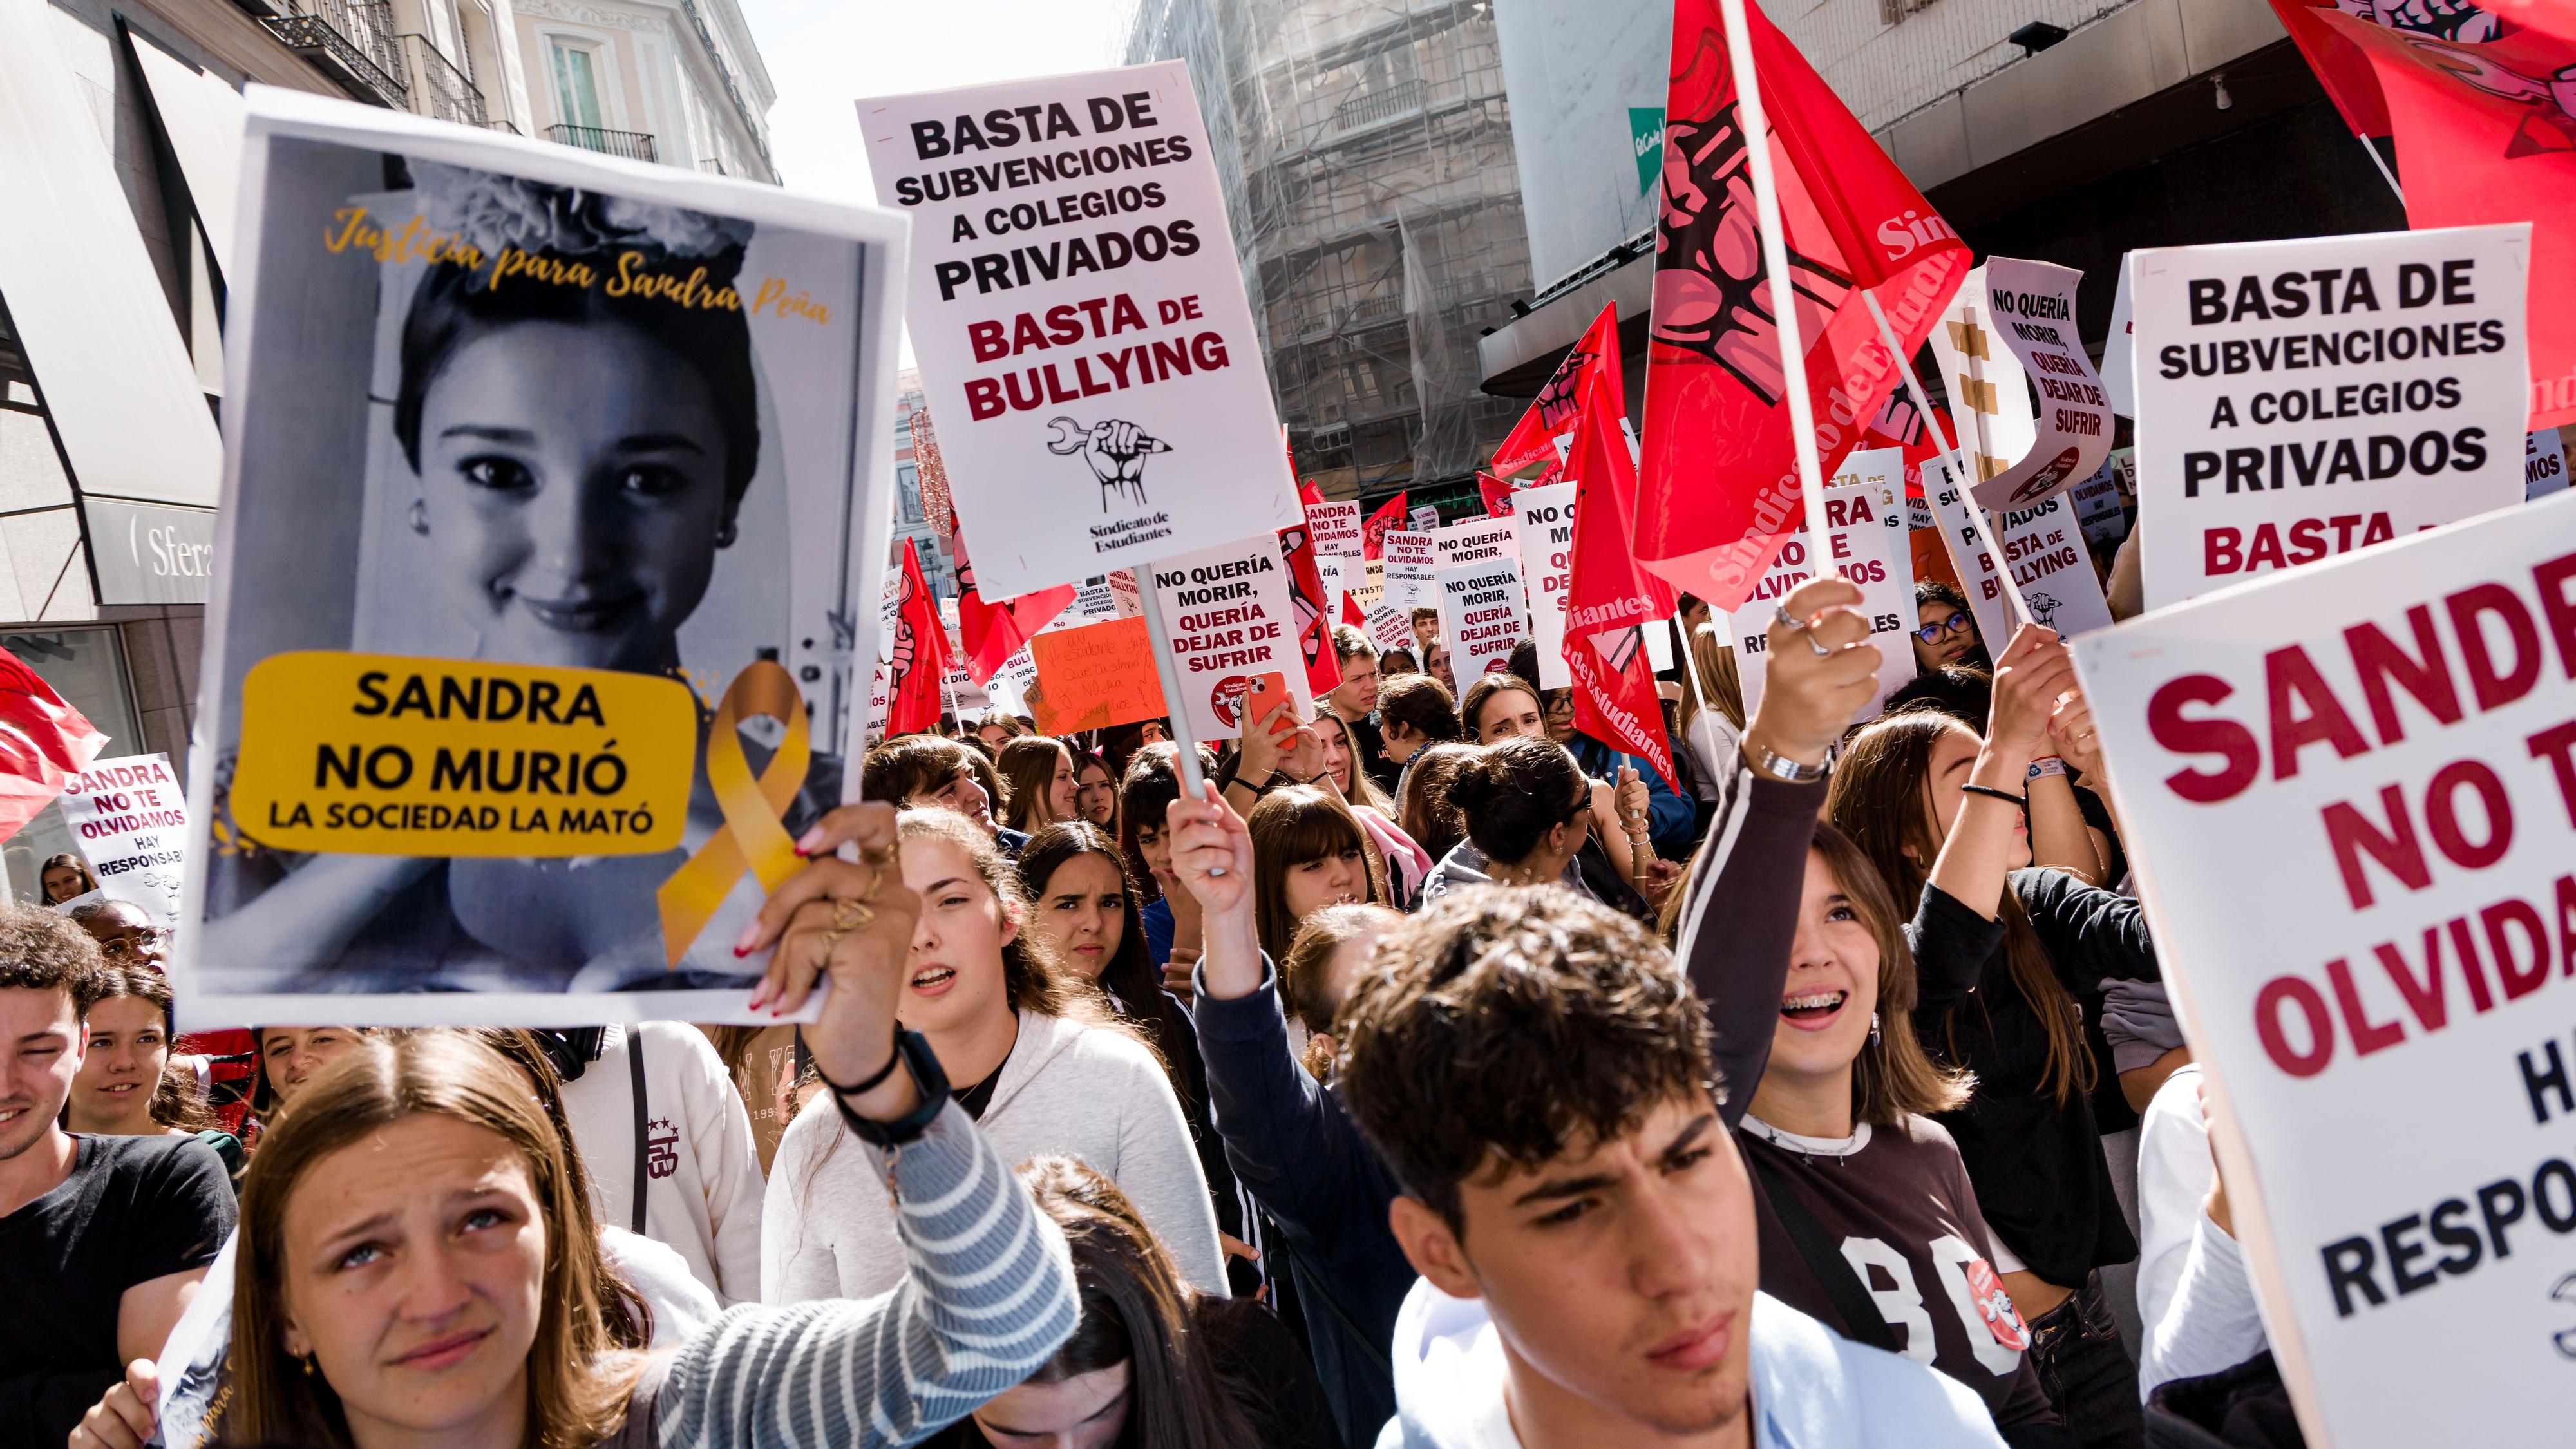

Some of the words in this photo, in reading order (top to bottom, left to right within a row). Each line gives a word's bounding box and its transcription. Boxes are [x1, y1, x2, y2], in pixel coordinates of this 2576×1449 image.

[911, 102, 1080, 160] BASTA
[1087, 91, 1158, 134] DE
[895, 135, 1192, 206] SUBVENCIONES
[952, 214, 978, 243] A
[984, 182, 1166, 236] COLEGIOS
[325, 207, 483, 268] Justicia
[490, 246, 598, 292] para
[605, 250, 743, 312] Sandra
[753, 276, 833, 325] Peña
[934, 219, 1200, 301] PRIVADOS
[1993, 289, 2014, 314] NO
[2018, 292, 2070, 321] QUERÍA
[2189, 267, 2381, 325] BASTA
[2398, 258, 2476, 310] DE
[968, 293, 1148, 363] BASTA
[1157, 294, 1203, 325] DE
[2011, 322, 2069, 352] MORIR,
[2159, 319, 2506, 379] SUBVENCIONES
[964, 330, 1230, 422] BULLYING
[2031, 350, 2087, 377] QUERÍA
[2040, 377, 2085, 403] DEJAR
[2084, 384, 2105, 407] DE
[2210, 396, 2239, 429] A
[2250, 376, 2461, 424] COLEGIOS
[2055, 407, 2101, 437] SUFRIR
[2183, 426, 2488, 498] PRIVADOS
[2074, 480, 2114, 502] OLVIDAMOS
[1089, 516, 1153, 540] Sindicato
[1152, 511, 1170, 526] de
[1307, 506, 1356, 520] ANDRA
[1312, 521, 1331, 531] NO
[1332, 519, 1347, 529] TE
[1526, 507, 1558, 526] NO
[1911, 513, 1931, 524] HAY
[1094, 527, 1172, 553] Estudiantes
[1387, 535, 1432, 546] SANDRA
[1438, 539, 1458, 551] NO
[1461, 529, 1513, 547] QUERÍA
[2046, 529, 2065, 547] DE
[2203, 511, 2396, 577] BASTA
[1388, 555, 1434, 564] OLVIDAMOS
[1452, 547, 1502, 563] MORIR,
[1155, 571, 1186, 589] NO
[1191, 554, 1274, 585] QUERÍA
[1445, 580, 1466, 594] NO
[1468, 571, 1517, 591] QUERÍA
[1980, 545, 2079, 601] BLLYING
[1079, 587, 1101, 598] BASTA
[1110, 579, 1139, 595] BULLYIN
[1177, 582, 1258, 607] MORIR,
[1462, 589, 1510, 607] MORIR,
[1179, 601, 1266, 632] QUERÍA
[1372, 608, 1399, 625] MORIR,
[1376, 613, 1404, 632] QUERÍA
[1376, 623, 1399, 640] DEJAR
[1401, 618, 1410, 627] DE
[1464, 604, 1513, 626] QUERÍA
[1173, 629, 1244, 654] DEJAR
[1249, 621, 1281, 641] DE
[1383, 625, 1410, 645] SUFRIR
[1461, 624, 1501, 643] DEJAR
[1504, 621, 1520, 634] DE
[1188, 645, 1273, 672] SUFRIR
[1470, 637, 1516, 656] SUFRIR
[352, 671, 605, 728] SANDRA
[1586, 668, 1673, 781] Estudiantes
[314, 744, 413, 790] NO
[430, 738, 627, 797] MURIÓ
[93, 792, 131, 815] NO
[133, 789, 161, 808] TE
[81, 810, 185, 839] OLVIDAMOS
[269, 801, 313, 828] LA
[325, 804, 500, 832] SOCIEDAD
[510, 807, 551, 834] LA
[558, 802, 653, 837] MATÓ
[134, 835, 161, 851] HAY
[2320, 758, 2514, 912] NO
[99, 849, 184, 877] RESPONSAB
